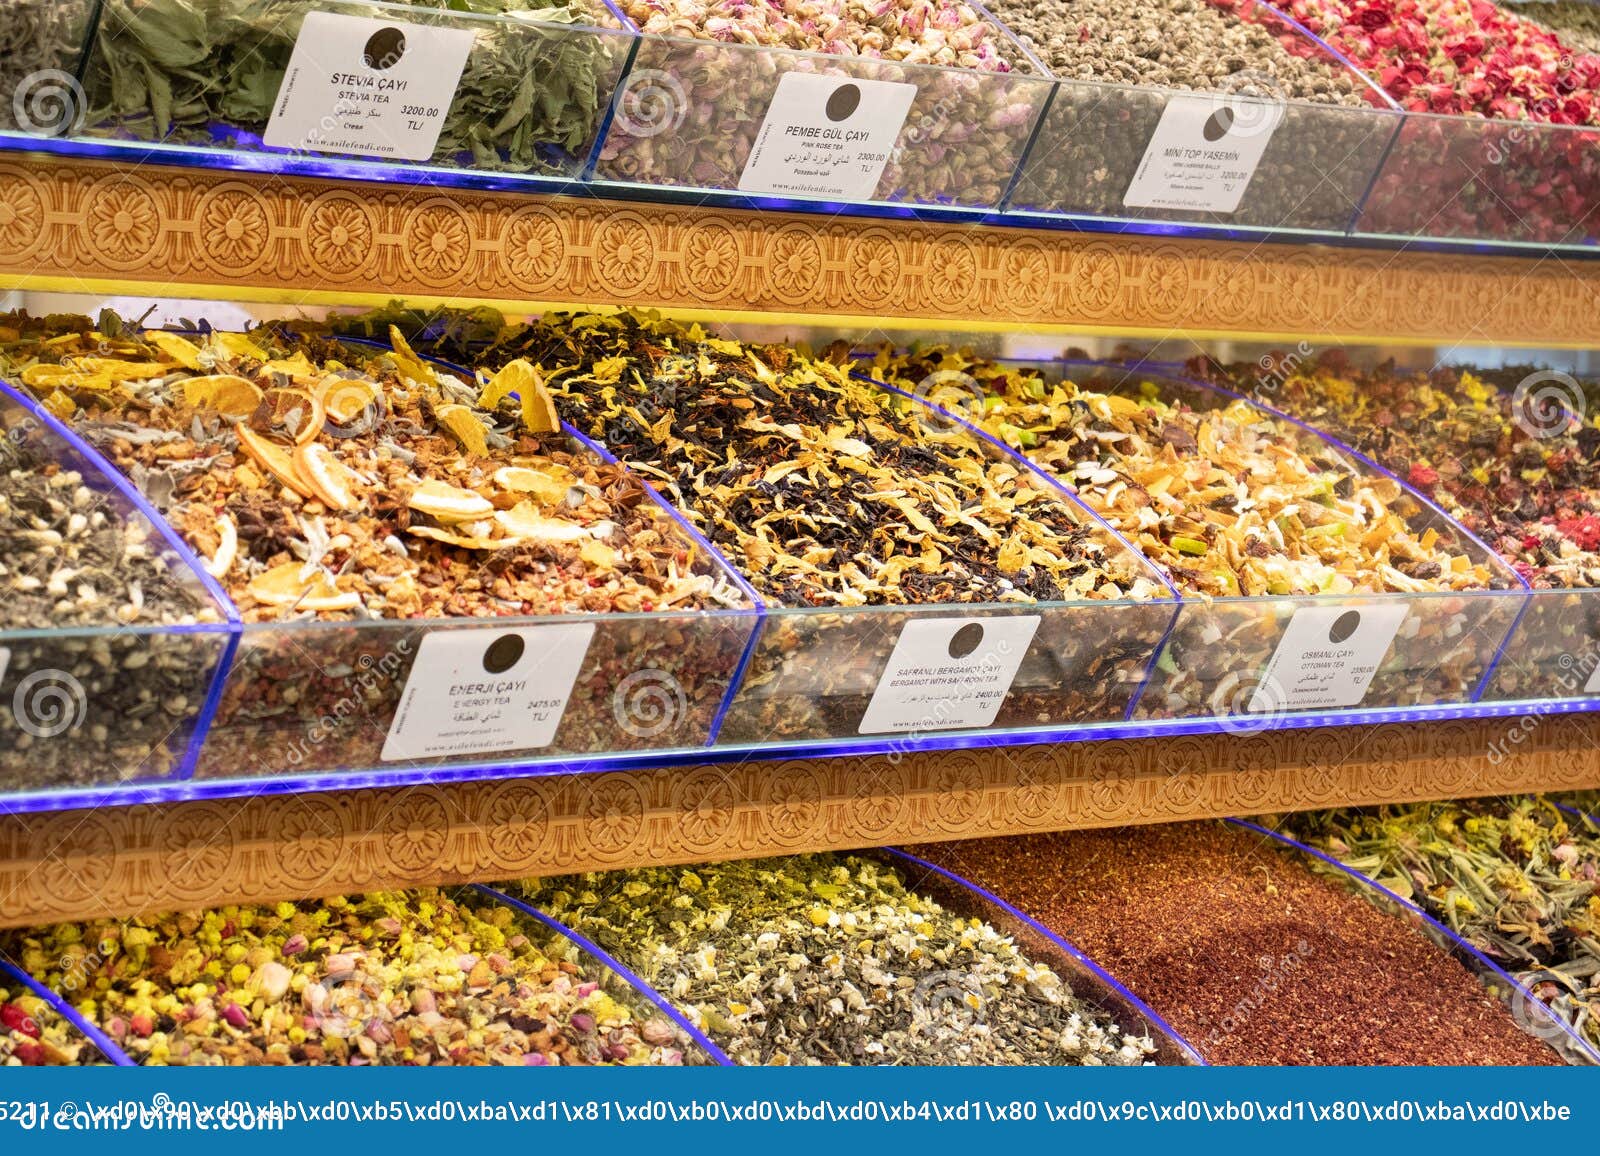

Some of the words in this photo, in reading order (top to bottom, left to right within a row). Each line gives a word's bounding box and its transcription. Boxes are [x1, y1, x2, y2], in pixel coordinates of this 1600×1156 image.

[331, 73, 374, 87] STEVIA
[377, 78, 408, 91] ÇAYI
[338, 90, 370, 101] STEVIA
[372, 94, 390, 103] TEA
[400, 105, 439, 118] 3200.00
[785, 126, 822, 138] PEMBE
[822, 127, 842, 139] GÜL
[845, 130, 869, 142] ÇAYI
[306, 139, 394, 153] www.asilefendi.com
[857, 152, 885, 162] 2300.00
[1184, 149, 1202, 159] TOP
[772, 183, 843, 194] www.asilefendi.com
[896, 667, 937, 677] SAFRANLI
[937, 666, 980, 675] BERGAMOT
[1301, 662, 1330, 670] OTTOMAN
[496, 681, 527, 693] ÇAYI
[890, 679, 928, 687] BERGAMOT
[494, 697, 510, 705] TEA
